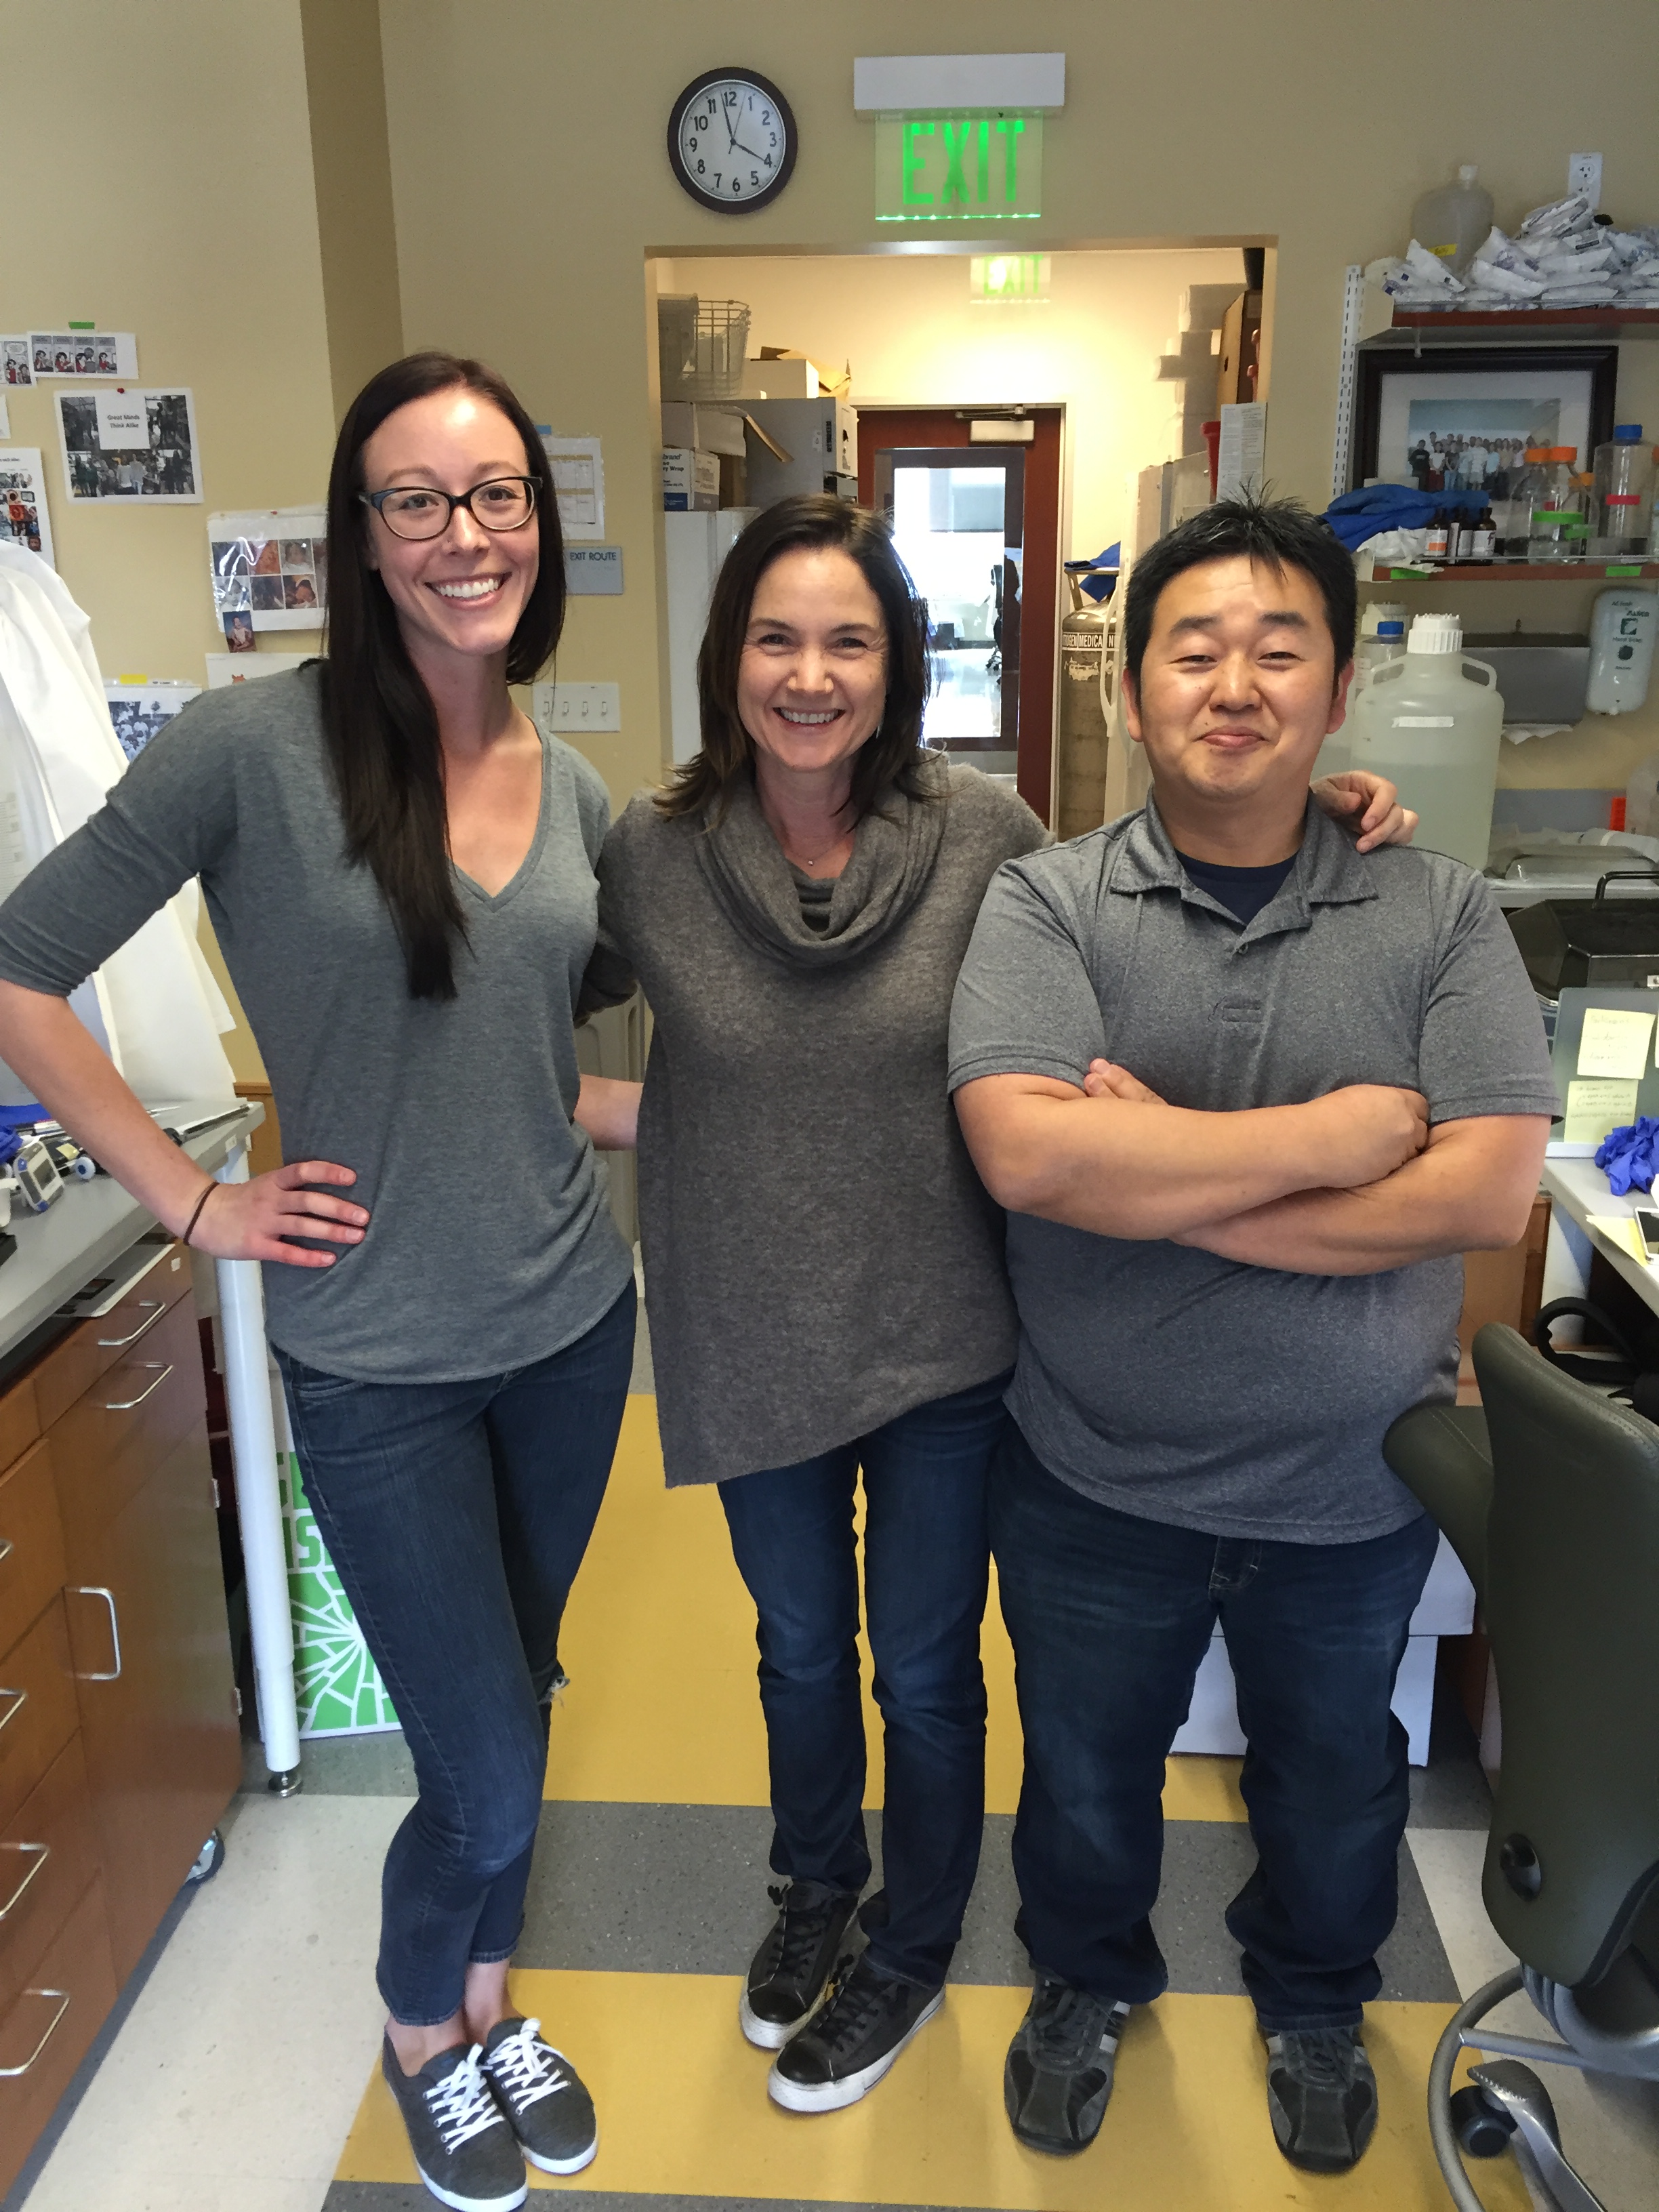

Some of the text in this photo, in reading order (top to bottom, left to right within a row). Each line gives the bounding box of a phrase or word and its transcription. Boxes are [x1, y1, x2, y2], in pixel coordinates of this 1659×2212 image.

[708, 98, 716, 114] 11
[723, 91, 737, 106] 12
[747, 96, 753, 111] 1
[693, 115, 708, 131] 10
[762, 110, 771, 125] 2
[689, 137, 697, 152] 9
[769, 131, 777, 147] 3
[697, 159, 705, 174] 8
[764, 153, 773, 168] 4
[902, 120, 1025, 205] EXIT
[714, 172, 722, 188] 7
[732, 177, 741, 192] 6
[750, 170, 759, 186] 5
[983, 254, 1043, 295] EXIT
[569, 552, 617, 561] EXIT ROUTE
[1079, 634, 1103, 648] MEDICA
